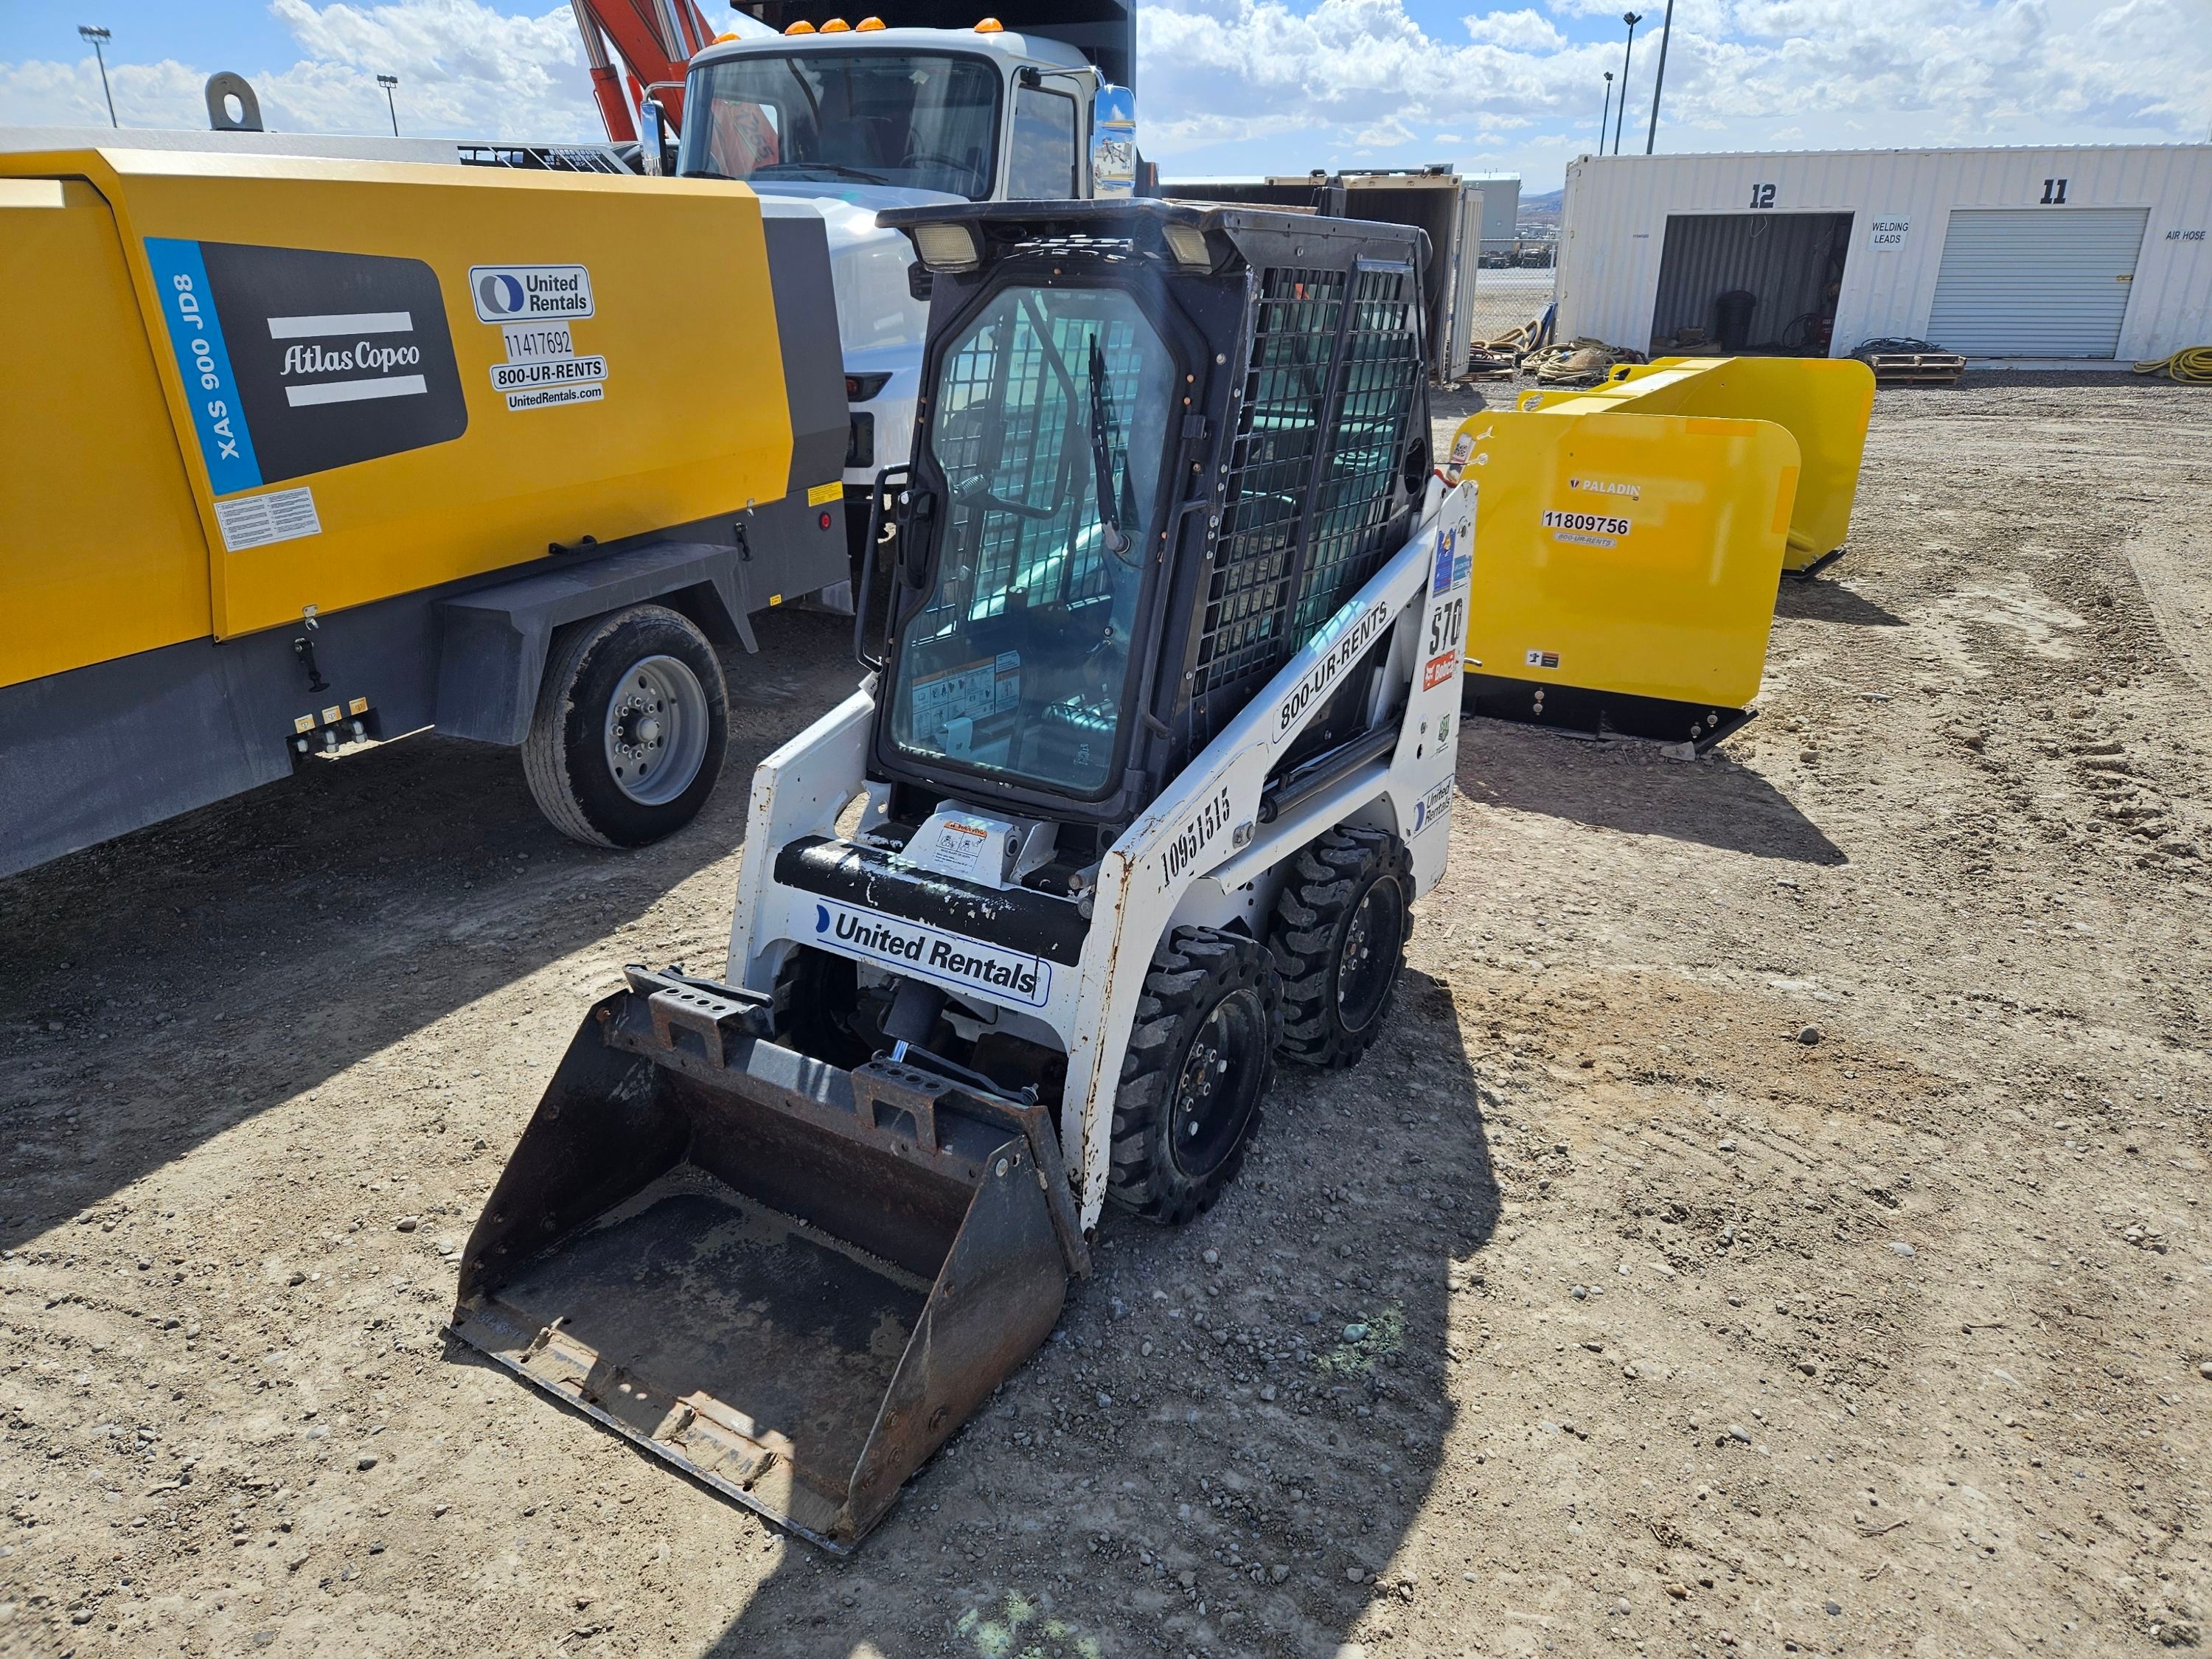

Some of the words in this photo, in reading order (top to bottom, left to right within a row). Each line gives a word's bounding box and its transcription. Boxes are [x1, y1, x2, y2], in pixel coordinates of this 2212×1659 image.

[1750, 183, 1777, 209] 12
[2040, 179, 2067, 204] 11
[1872, 222, 1909, 232] WELDING
[1874, 234, 1901, 243] LEADS
[2166, 230, 2181, 240] AIR
[2183, 230, 2206, 240] HOSE
[526, 274, 578, 292] United
[173, 274, 204, 330] JD8
[530, 293, 587, 311] Rentals
[504, 331, 572, 358] 11417692
[192, 339, 220, 390] 900
[280, 344, 354, 375] Atlas
[355, 341, 420, 373] Copco
[497, 360, 602, 386] 800-UR-RENTS
[509, 388, 602, 408] UnitedRentals.com
[209, 400, 240, 459] XAS
[1583, 480, 1640, 495] PALADIN
[1545, 512, 1629, 535] 11809756
[1559, 535, 1611, 546] 800-UR-RENTS
[1429, 597, 1463, 656] S70
[1279, 600, 1388, 731] 800-UR-RENTS
[1427, 780, 1450, 807] United
[1425, 796, 1451, 826] Rentals
[1161, 787, 1231, 888] 10951515
[835, 912, 926, 962] United
[930, 939, 1037, 995] Rentals
